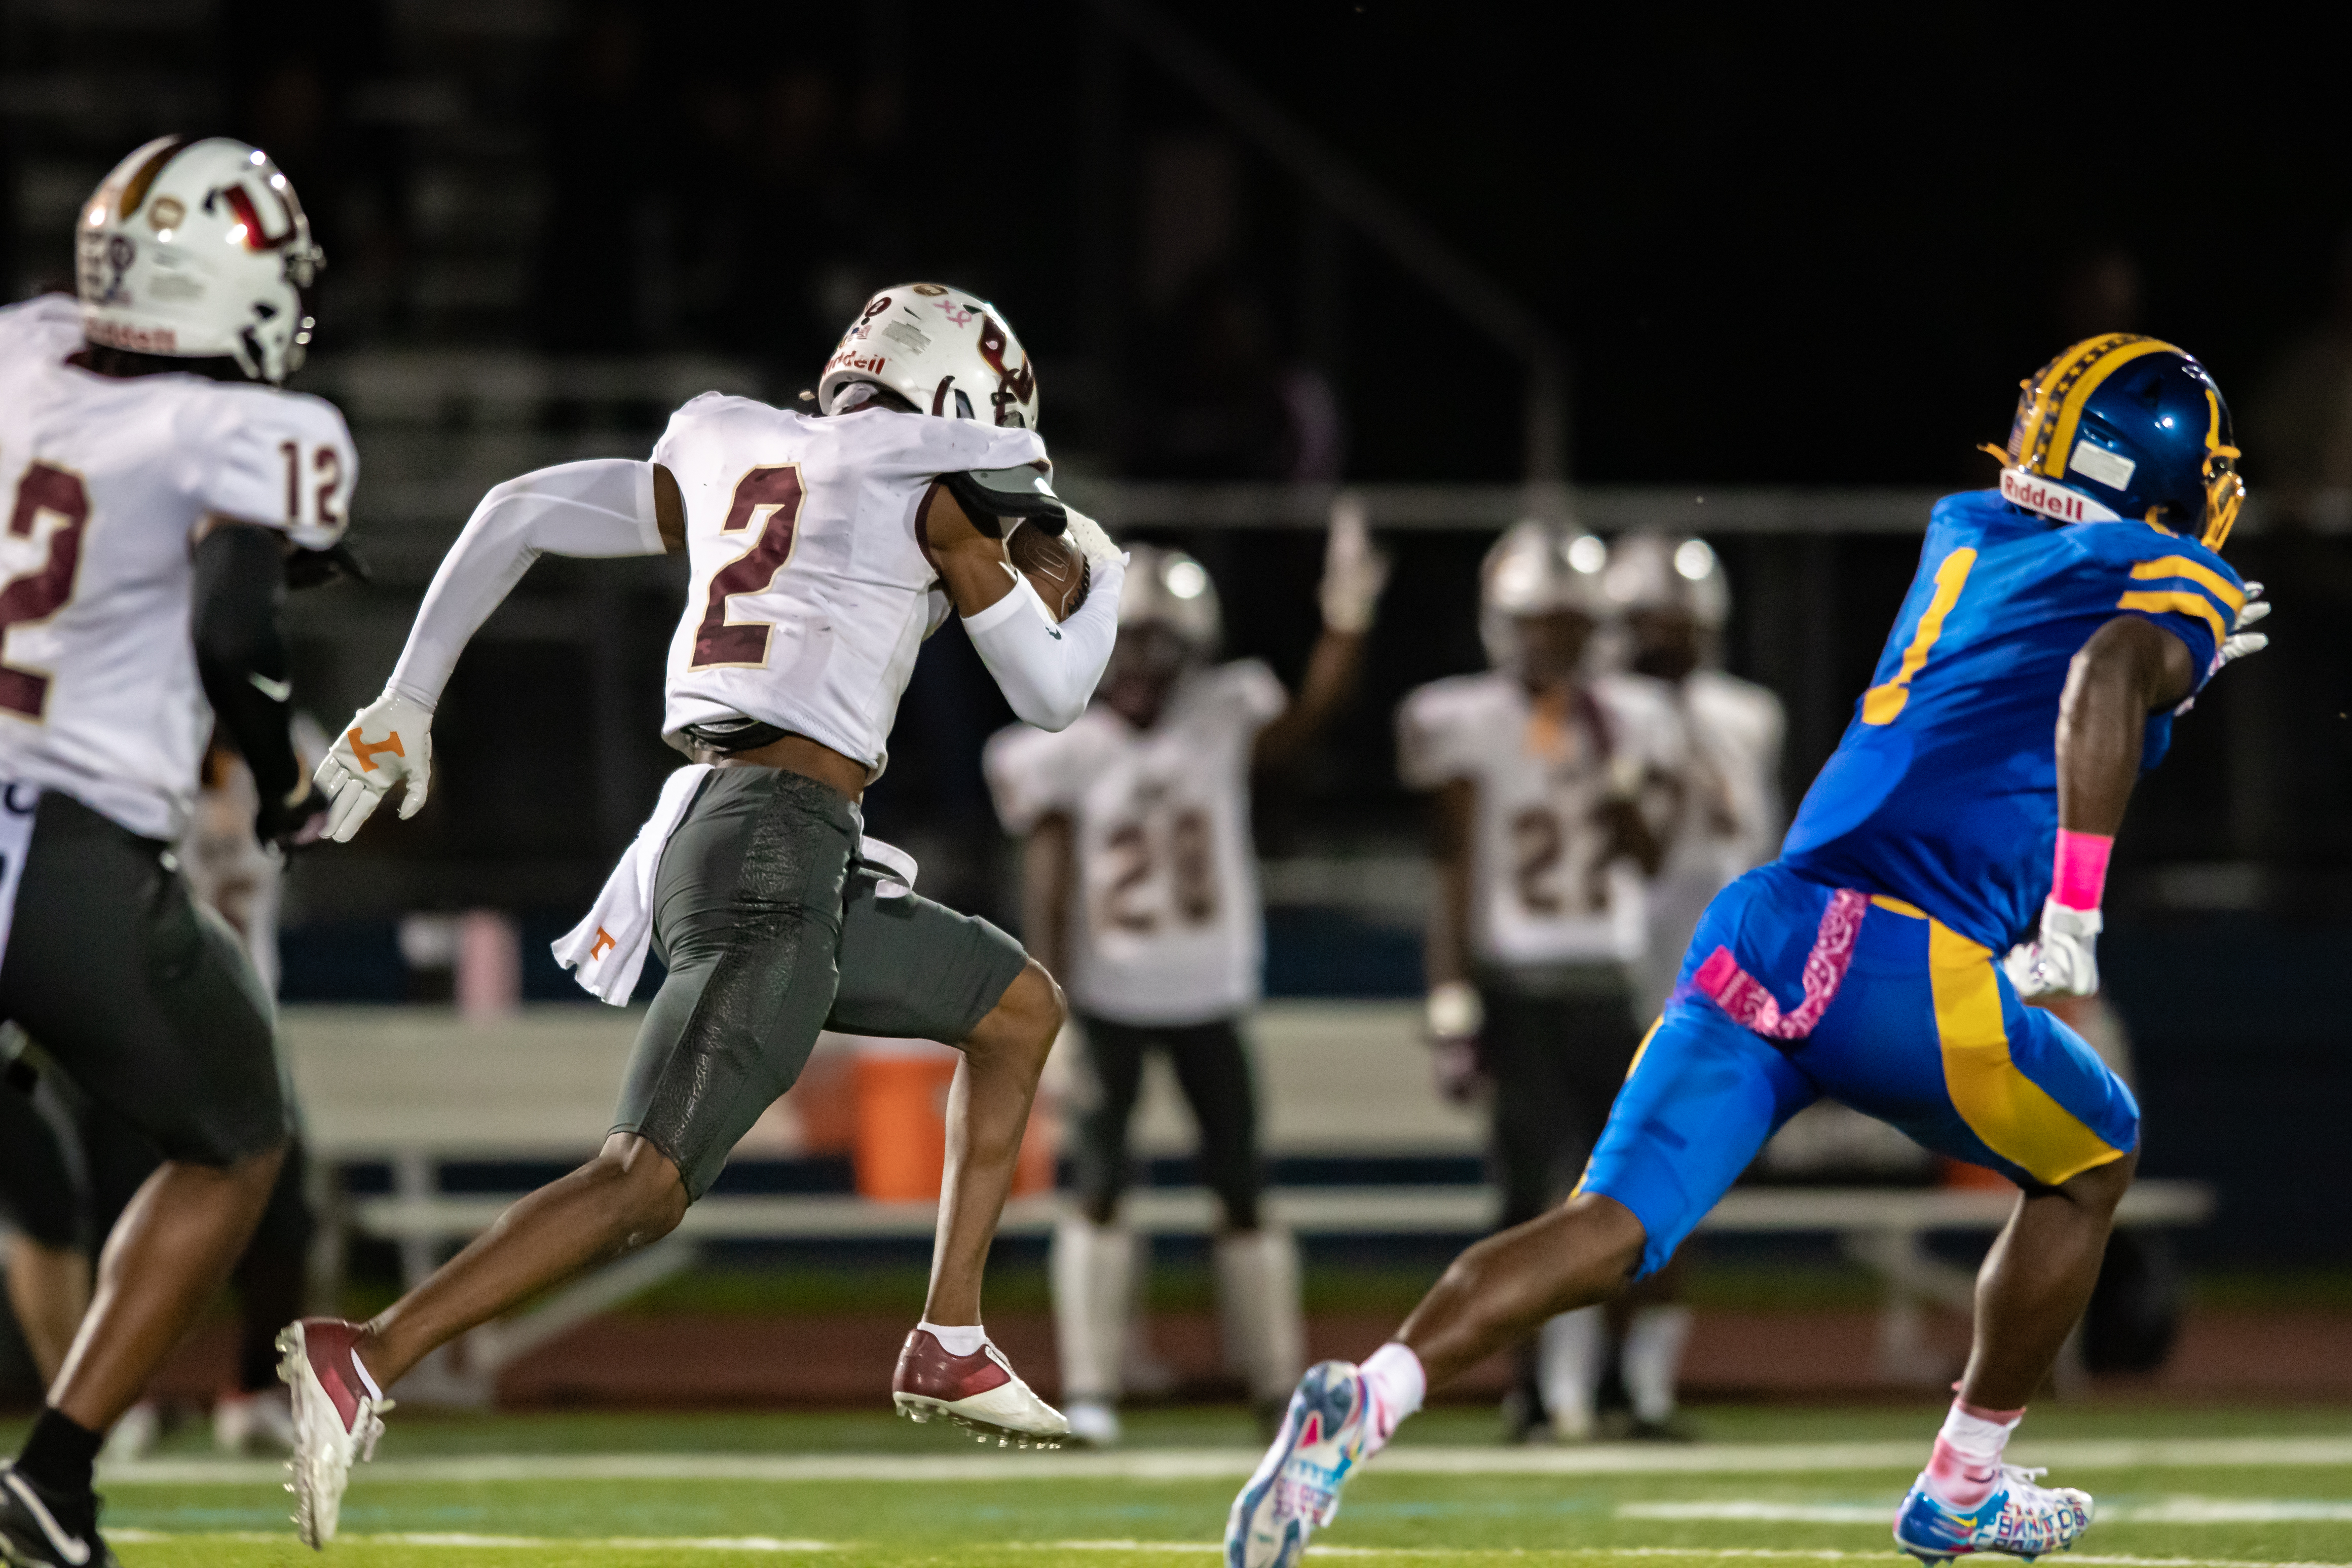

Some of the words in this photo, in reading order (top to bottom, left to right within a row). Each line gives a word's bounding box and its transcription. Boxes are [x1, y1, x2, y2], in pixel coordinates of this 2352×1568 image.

[279, 439, 345, 528] 12
[2003, 474, 2084, 522] Riddell
[687, 461, 809, 674] 2
[1861, 547, 1978, 726] 1
[347, 726, 405, 773] T
[590, 925, 616, 961] T
